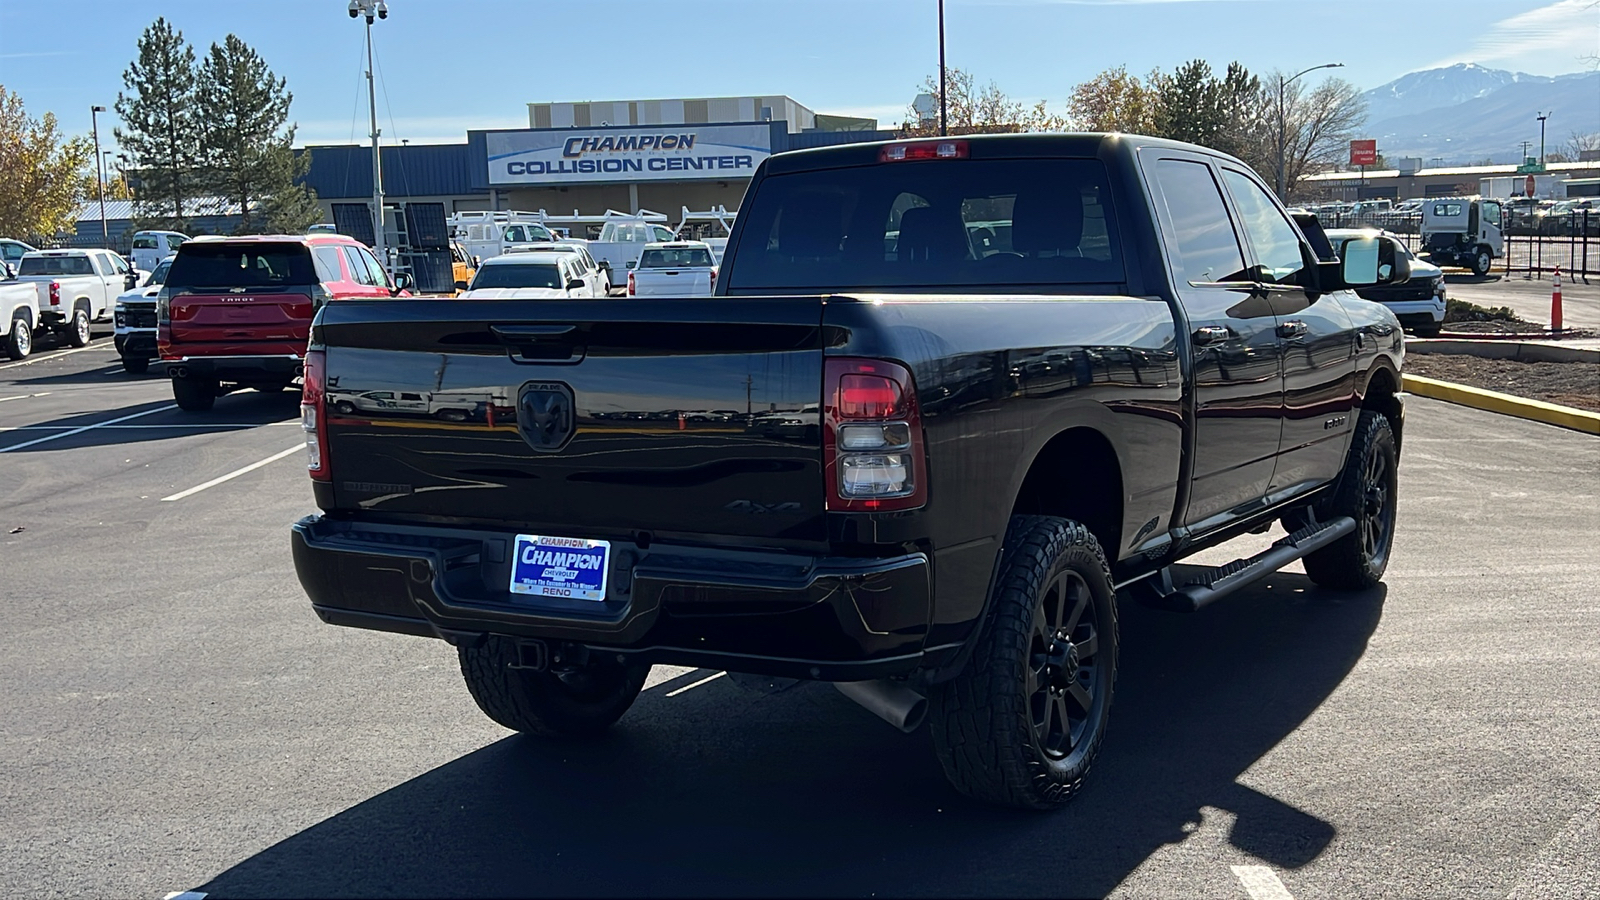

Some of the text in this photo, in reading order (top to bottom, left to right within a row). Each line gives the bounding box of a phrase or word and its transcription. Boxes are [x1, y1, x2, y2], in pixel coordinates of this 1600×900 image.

[563, 133, 696, 158] CHAMPION
[507, 155, 753, 175] COLLISION CENTER
[540, 537, 584, 548] CHAMPION
[521, 546, 602, 570] CHAMPION
[544, 569, 576, 578] CHEVROLET
[542, 587, 572, 597] RENO
